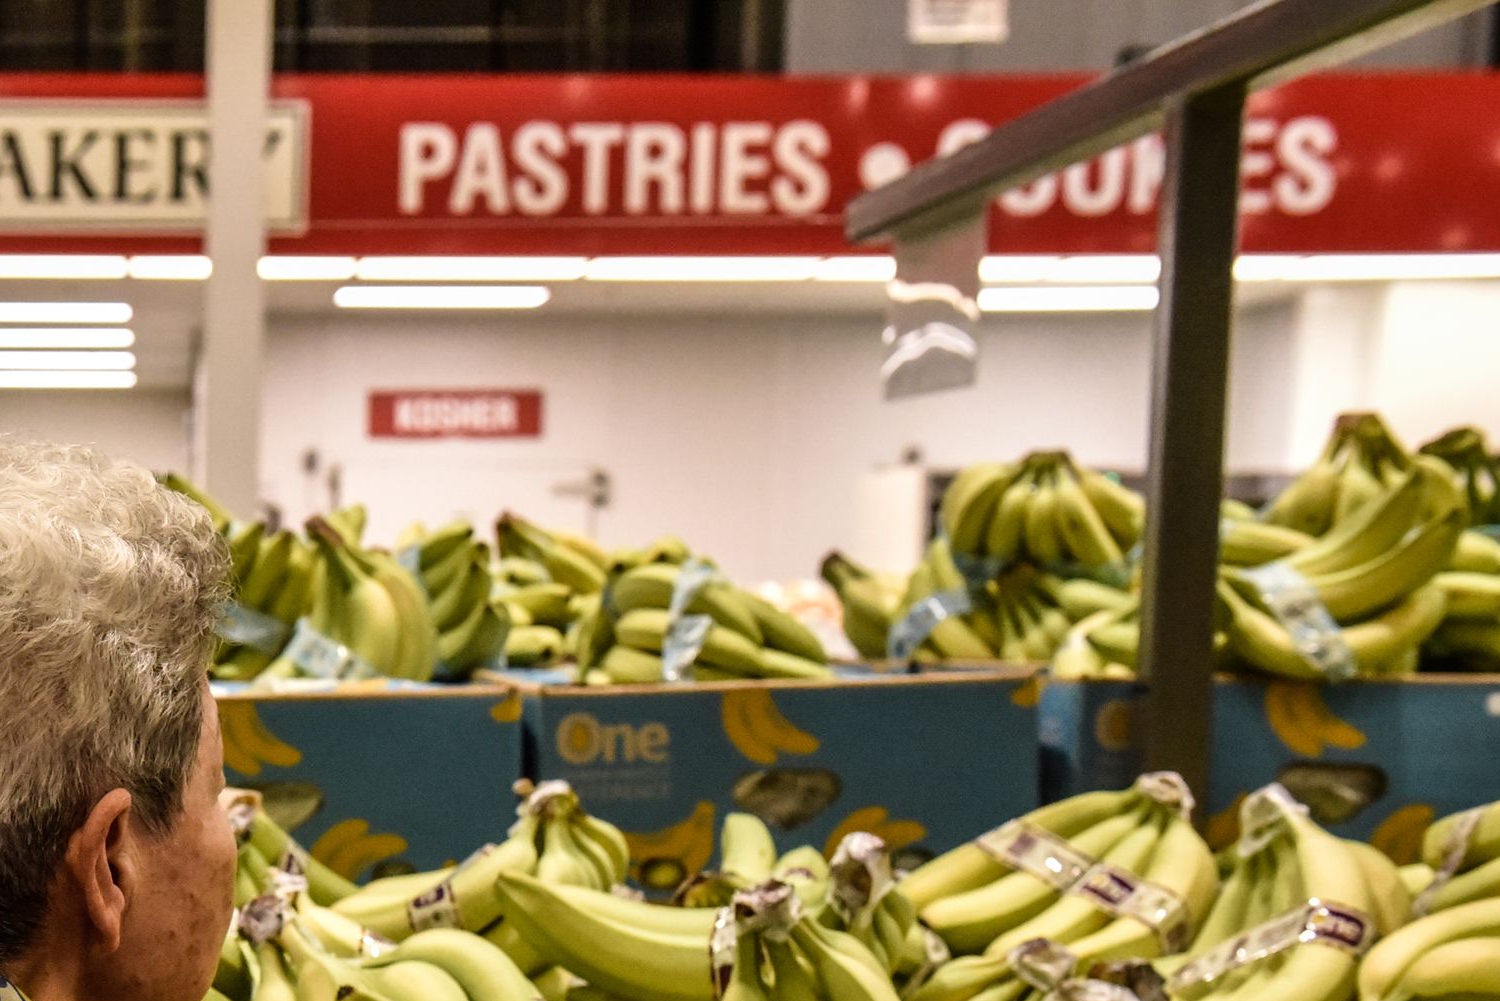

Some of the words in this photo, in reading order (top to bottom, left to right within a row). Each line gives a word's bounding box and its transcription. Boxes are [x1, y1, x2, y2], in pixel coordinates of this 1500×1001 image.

[398, 118, 832, 217] PASTRIES
[393, 397, 518, 433] KOSHER
[556, 711, 670, 765] One
